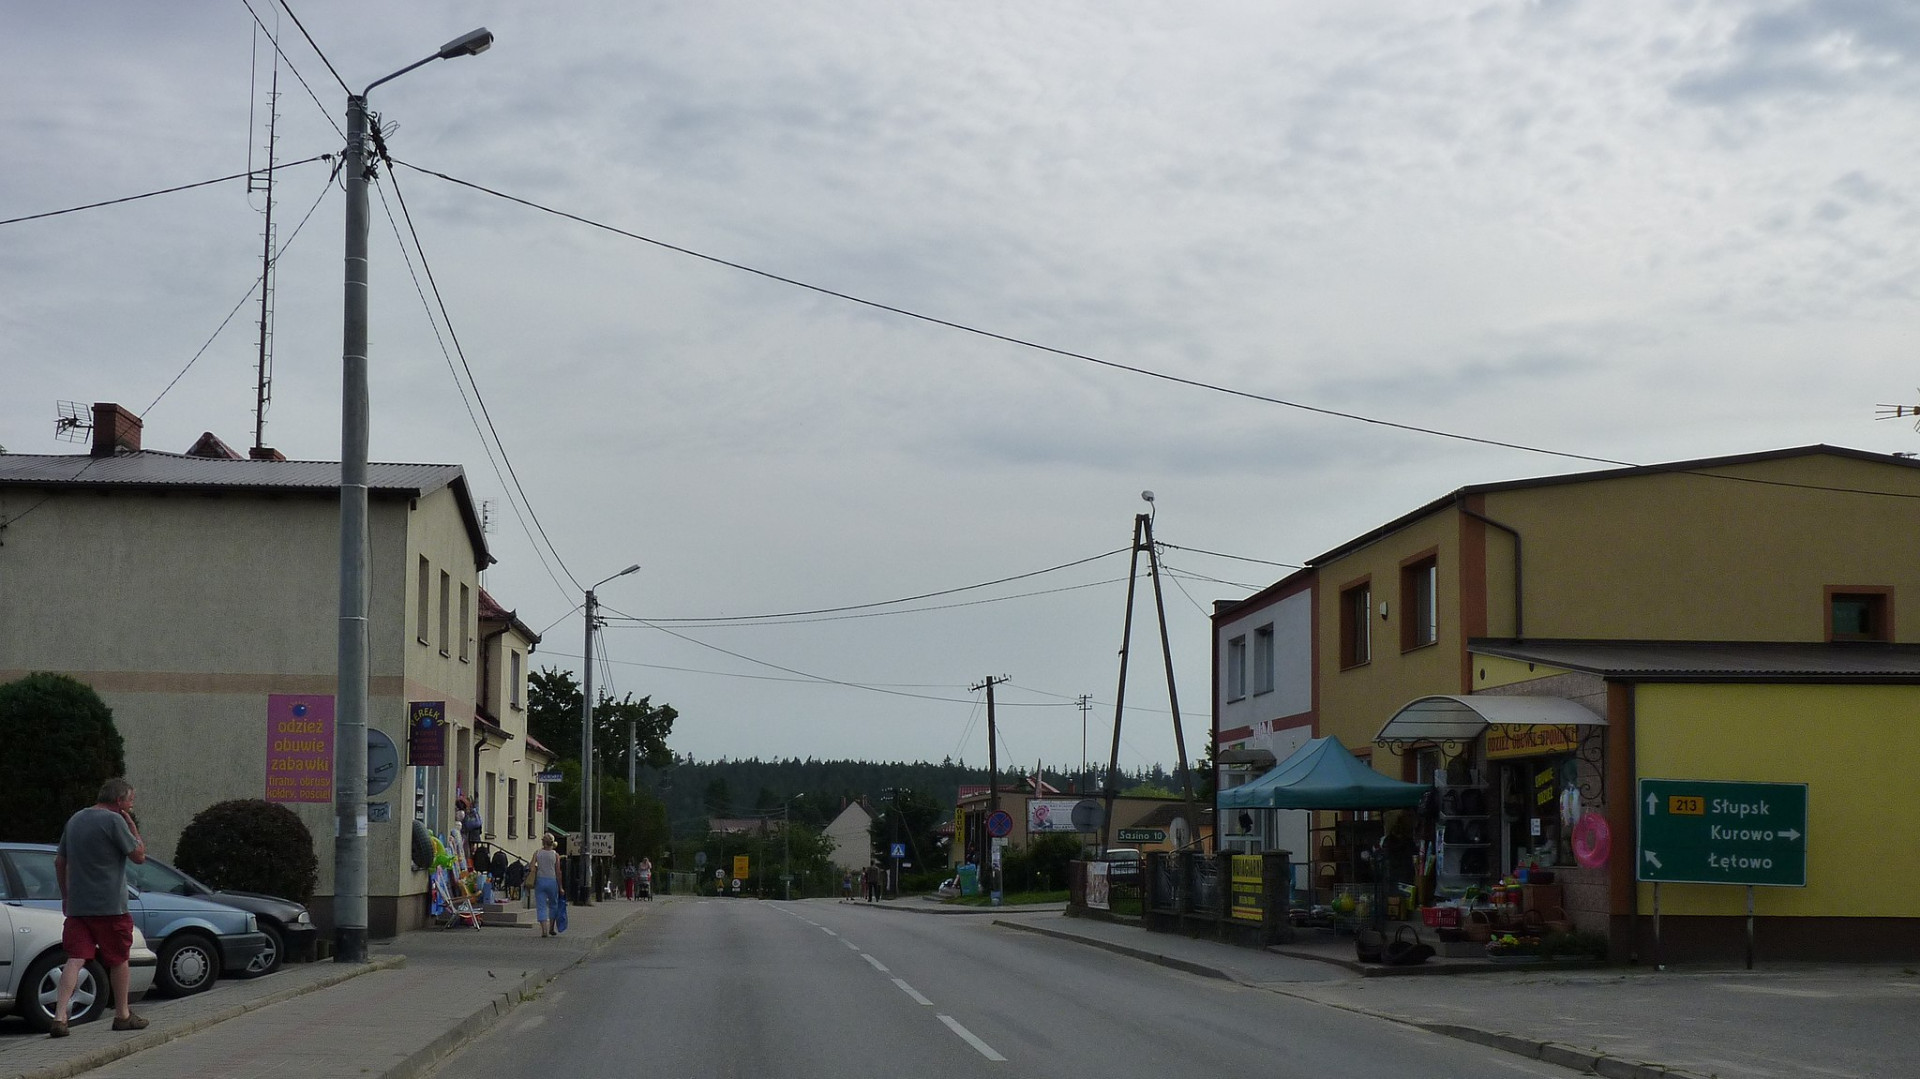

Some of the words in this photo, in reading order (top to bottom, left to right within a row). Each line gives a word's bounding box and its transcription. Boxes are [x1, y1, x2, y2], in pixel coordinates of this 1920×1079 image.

[411, 707, 445, 727] PEREŁKA
[278, 718, 324, 733] odzież
[274, 738, 325, 752] obuwie
[271, 756, 330, 771] zabawki
[300, 776, 331, 787] obrusy
[1676, 799, 1697, 812] 213
[1712, 799, 1770, 818] Słupsk
[1120, 830, 1150, 840] Sasino
[1154, 831, 1163, 840] 10
[1711, 824, 1773, 841] Kurowo
[1708, 852, 1773, 872] Łętowo
